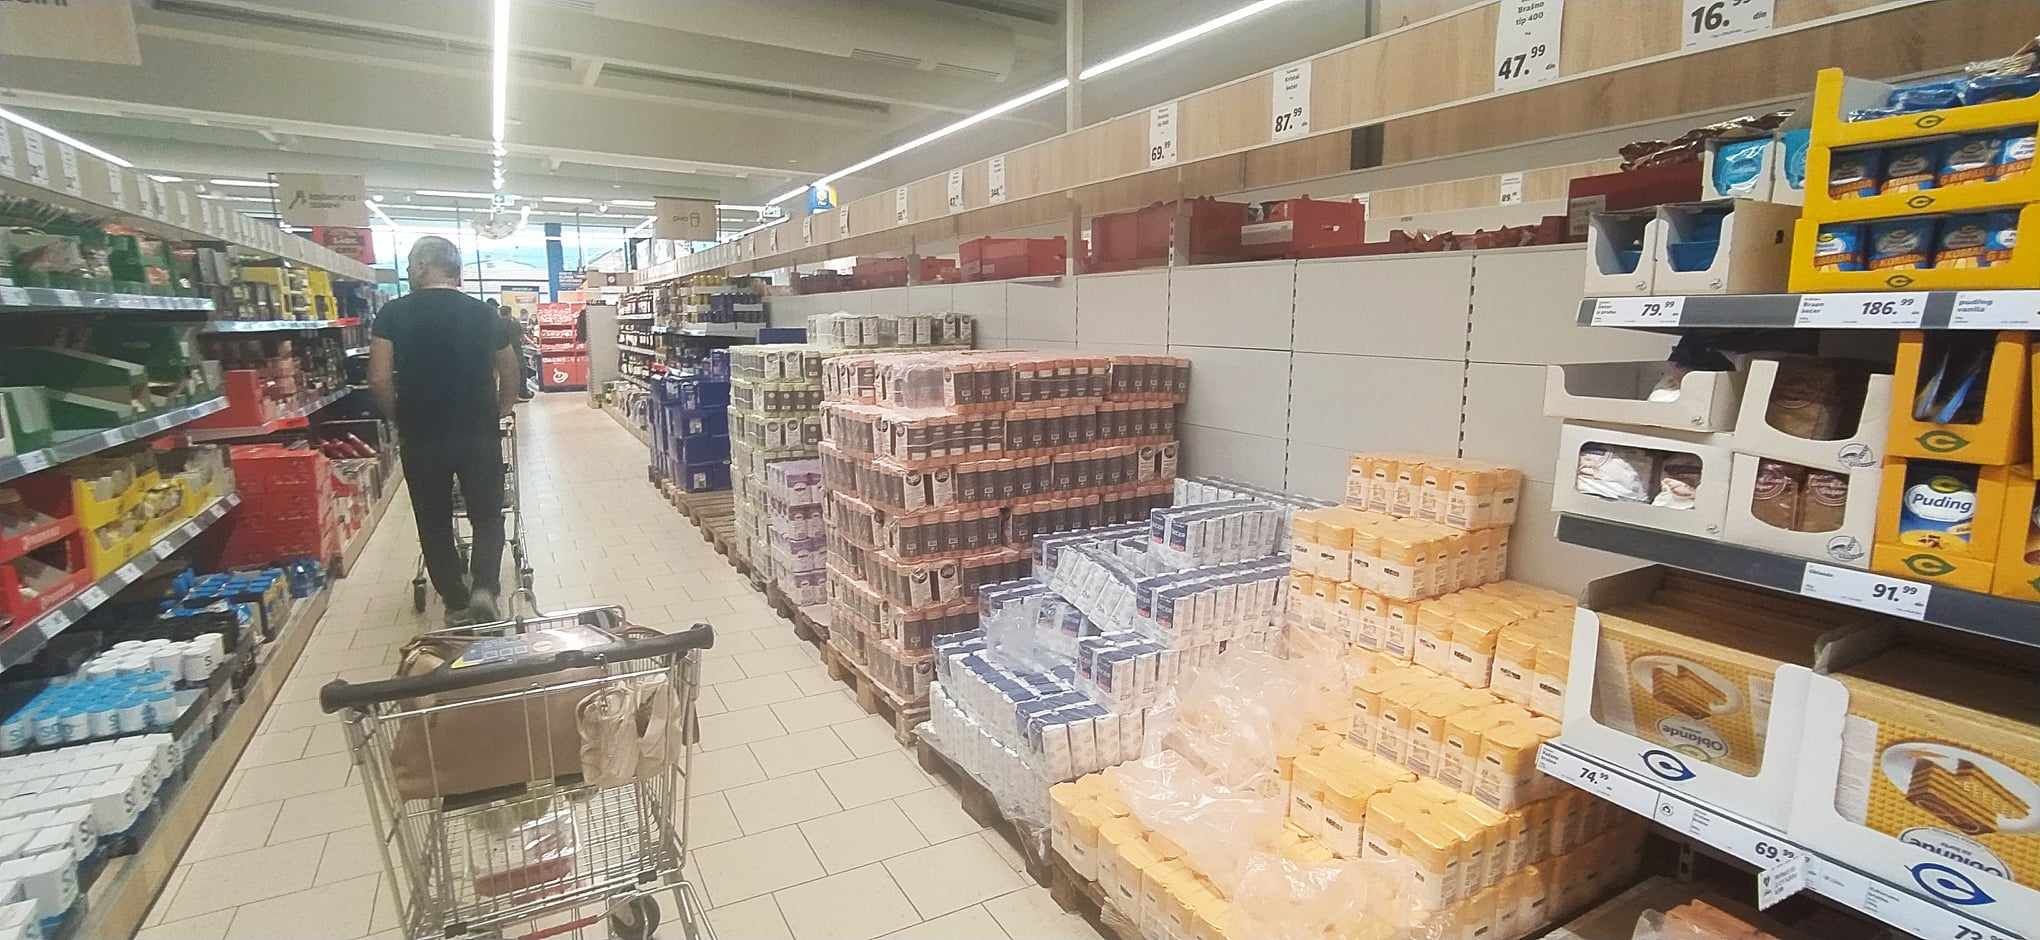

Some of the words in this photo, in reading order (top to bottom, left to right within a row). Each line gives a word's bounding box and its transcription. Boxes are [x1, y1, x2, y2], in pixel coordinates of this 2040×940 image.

[1528, 12, 1544, 21] 400
[1912, 493, 1973, 513] Puding
[1662, 724, 1723, 751] Oblande
